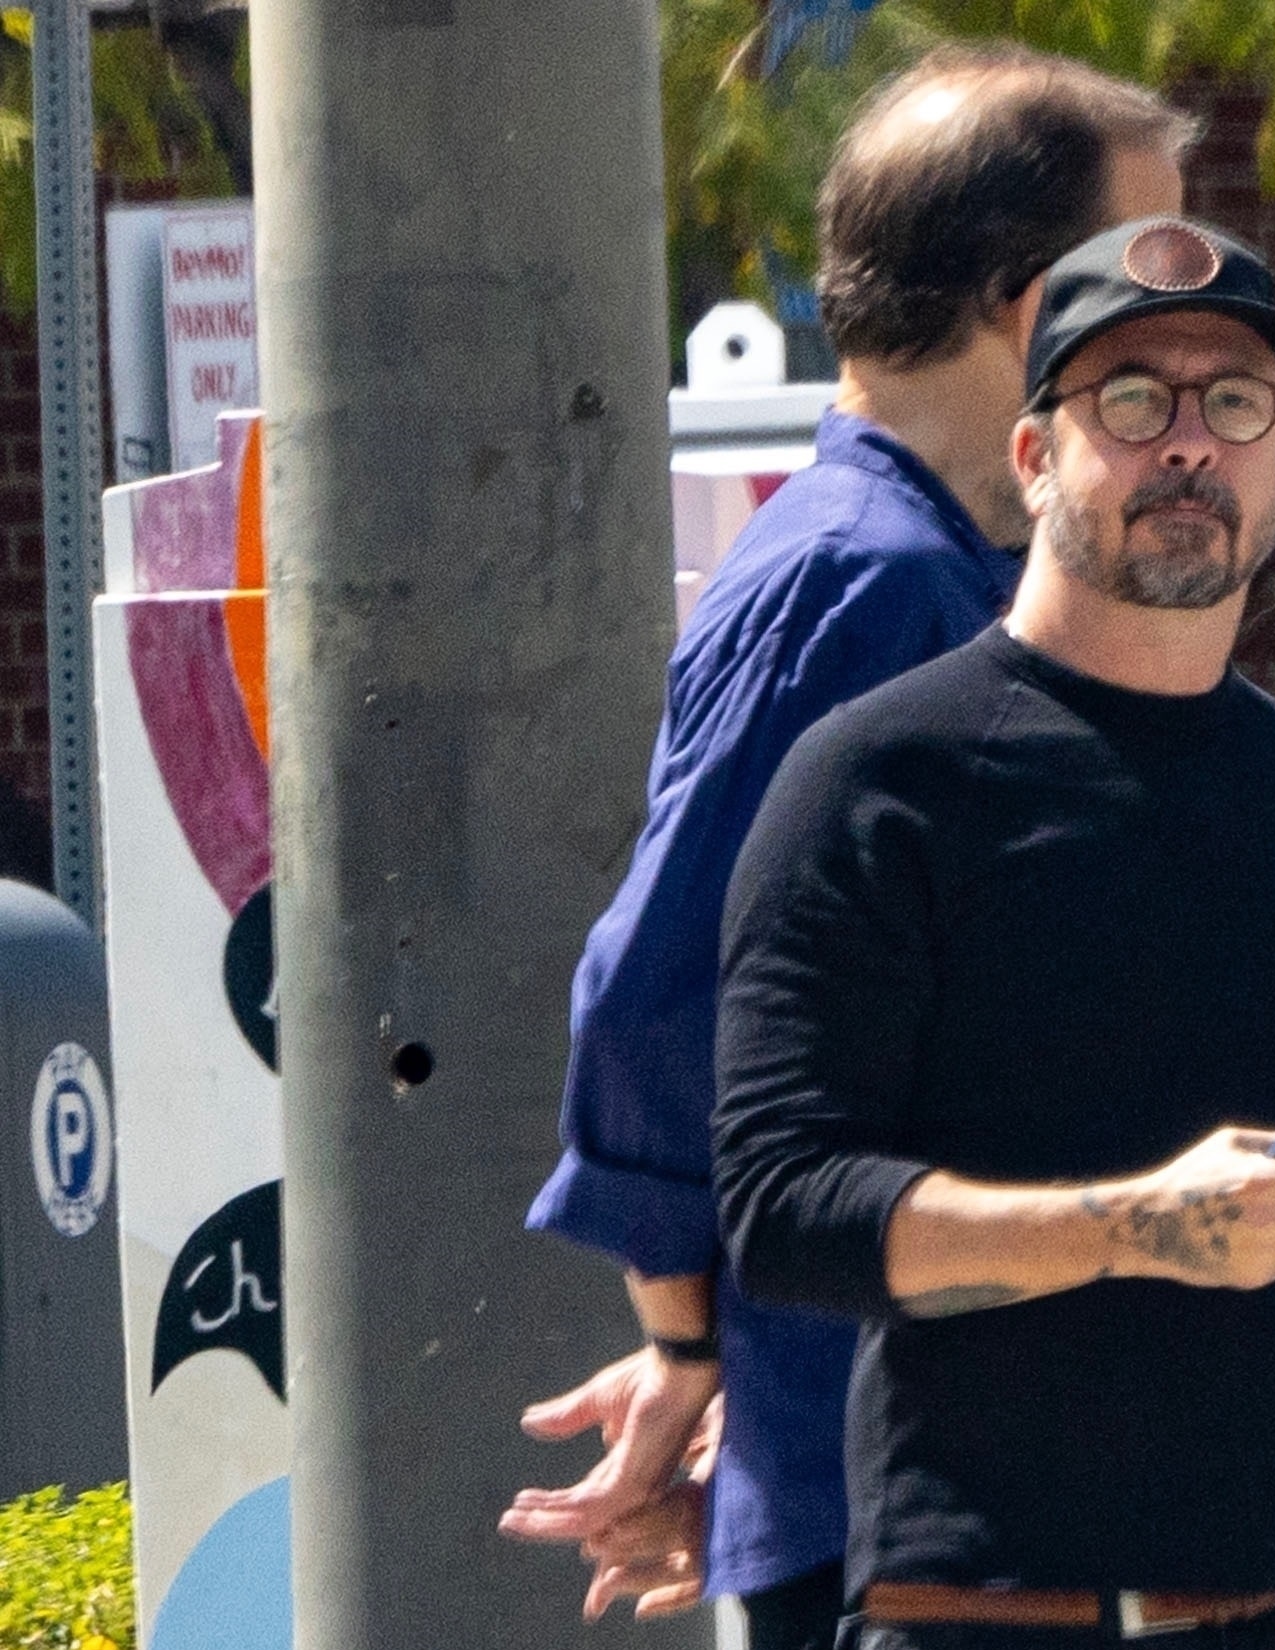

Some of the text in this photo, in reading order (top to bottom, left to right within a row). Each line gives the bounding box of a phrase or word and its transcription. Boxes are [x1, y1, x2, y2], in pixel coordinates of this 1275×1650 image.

[173, 303, 252, 340] PARKING
[191, 365, 235, 401] ONLY
[57, 1092, 88, 1187] P
